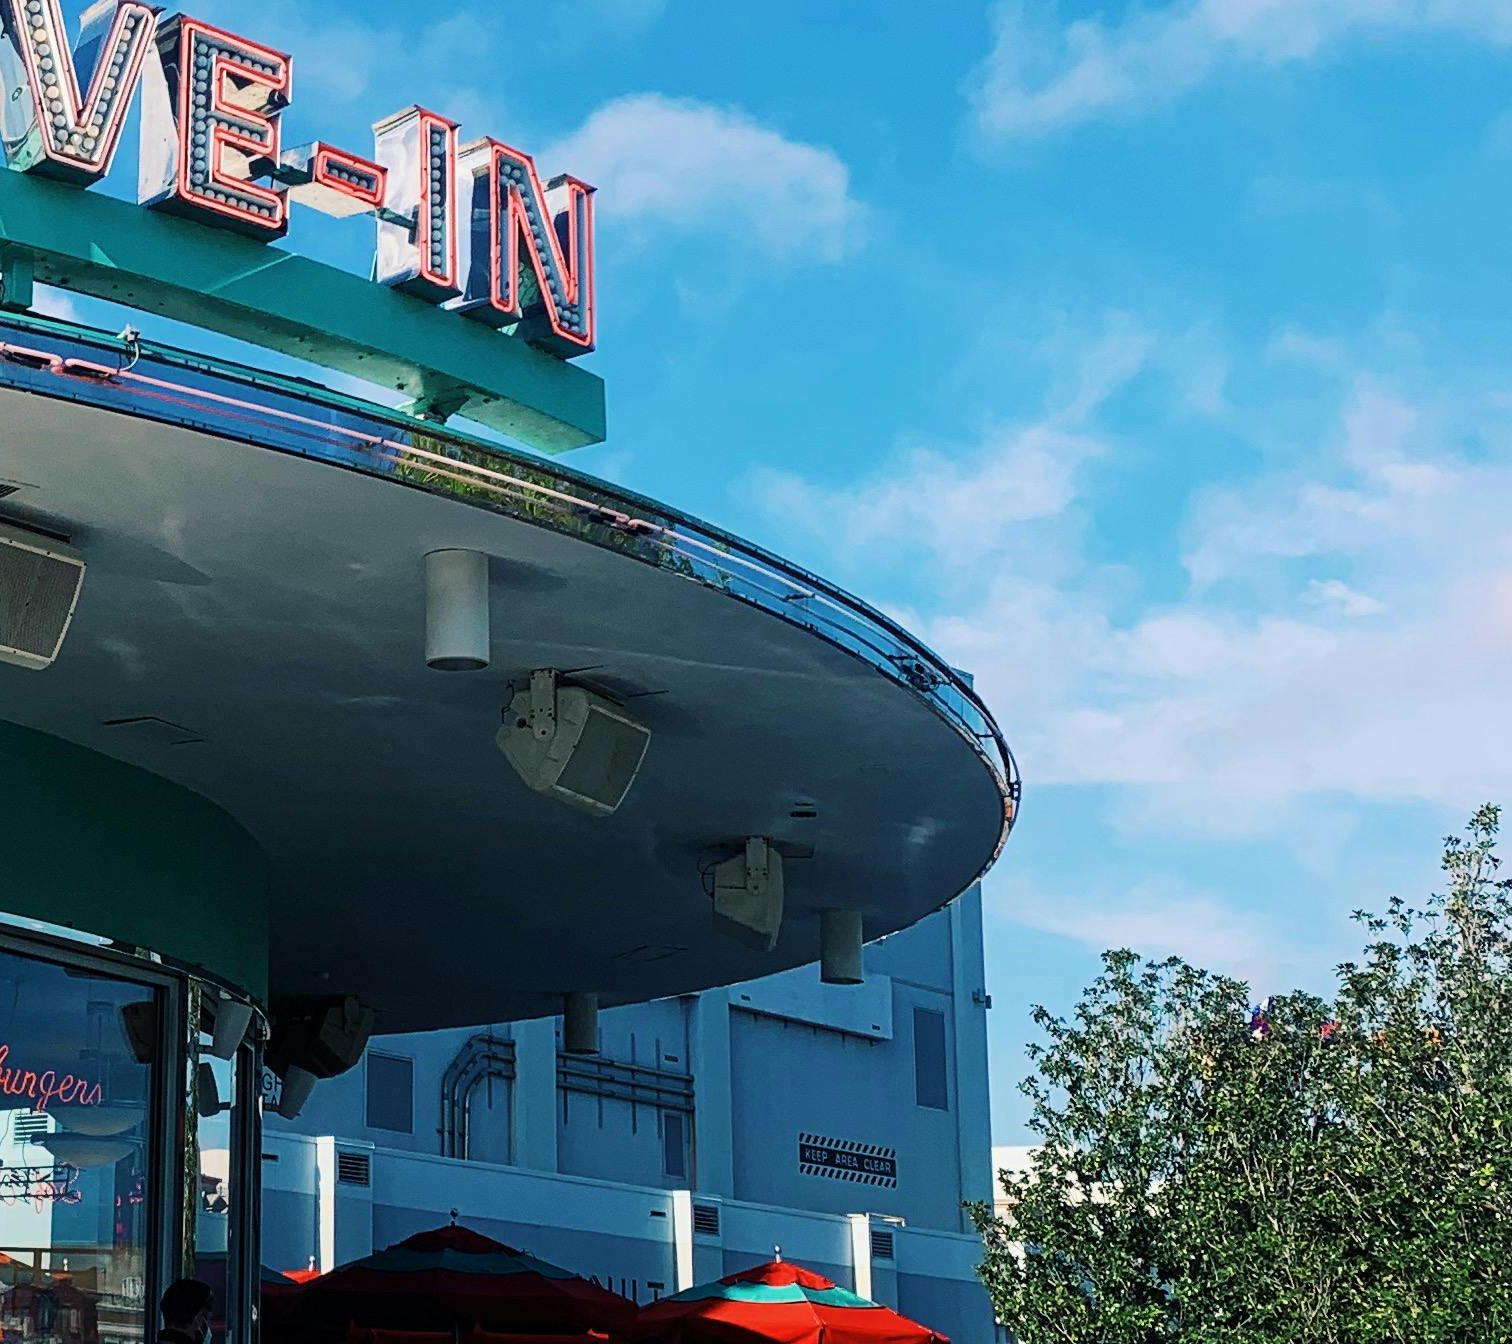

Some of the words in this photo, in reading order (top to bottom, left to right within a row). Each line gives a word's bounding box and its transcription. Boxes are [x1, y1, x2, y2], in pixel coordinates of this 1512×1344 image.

[804, 1147, 829, 1163] KEEP
[835, 1153, 859, 1169] AREA
[863, 1157, 892, 1173] CLEAR
